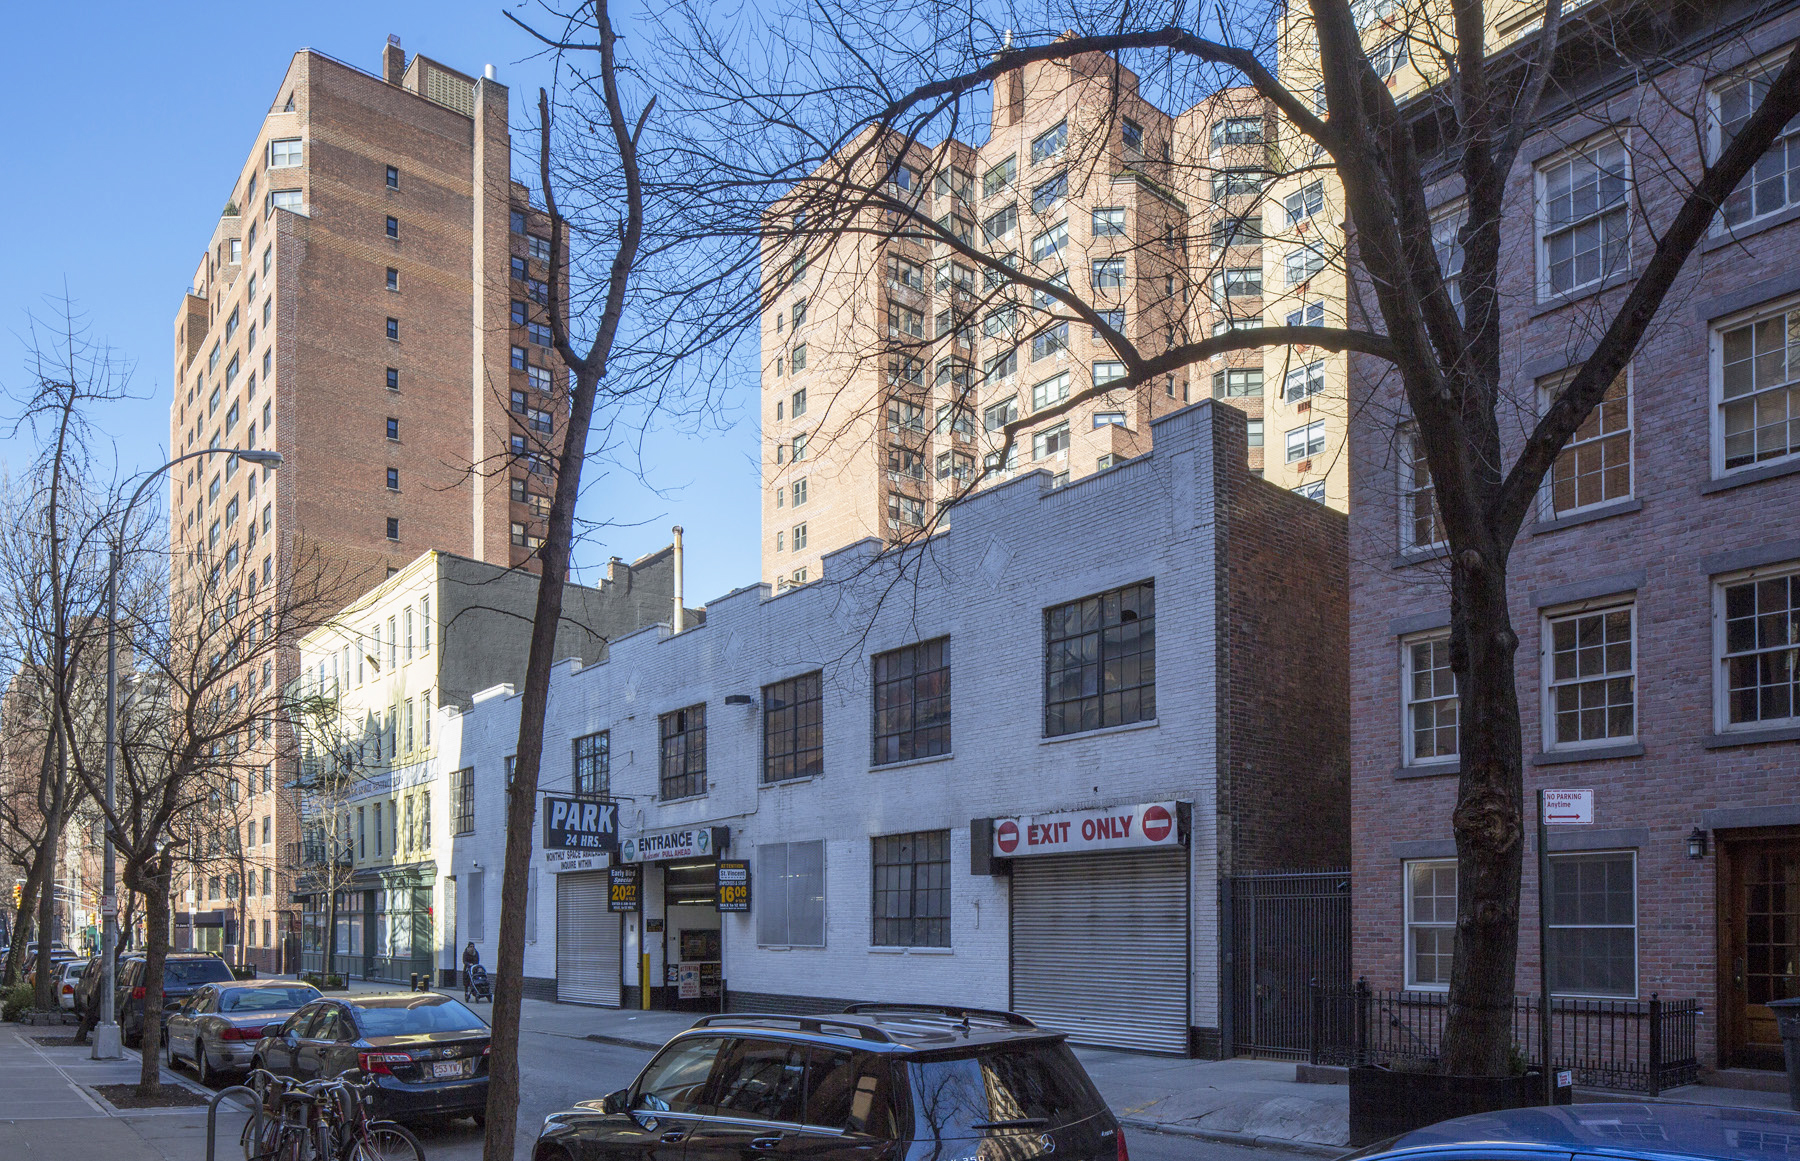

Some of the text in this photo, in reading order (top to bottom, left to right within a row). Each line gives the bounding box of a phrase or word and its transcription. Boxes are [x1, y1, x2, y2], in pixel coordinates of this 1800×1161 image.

[1547, 801, 1571, 809] Anytime
[551, 800, 615, 833] PARK
[1027, 815, 1134, 846] EXIT ONLY
[565, 833, 602, 848] 24 HRS.
[639, 832, 693, 852] ENTRANCE
[546, 851, 566, 862] MONTHLY
[566, 850, 581, 860] SPACE
[662, 848, 674, 858] PULL
[674, 847, 692, 856] AHEAD
[560, 859, 593, 870] INQUIRE WITHIN
[611, 869, 624, 878] Early
[434, 1063, 448, 1074] 253
